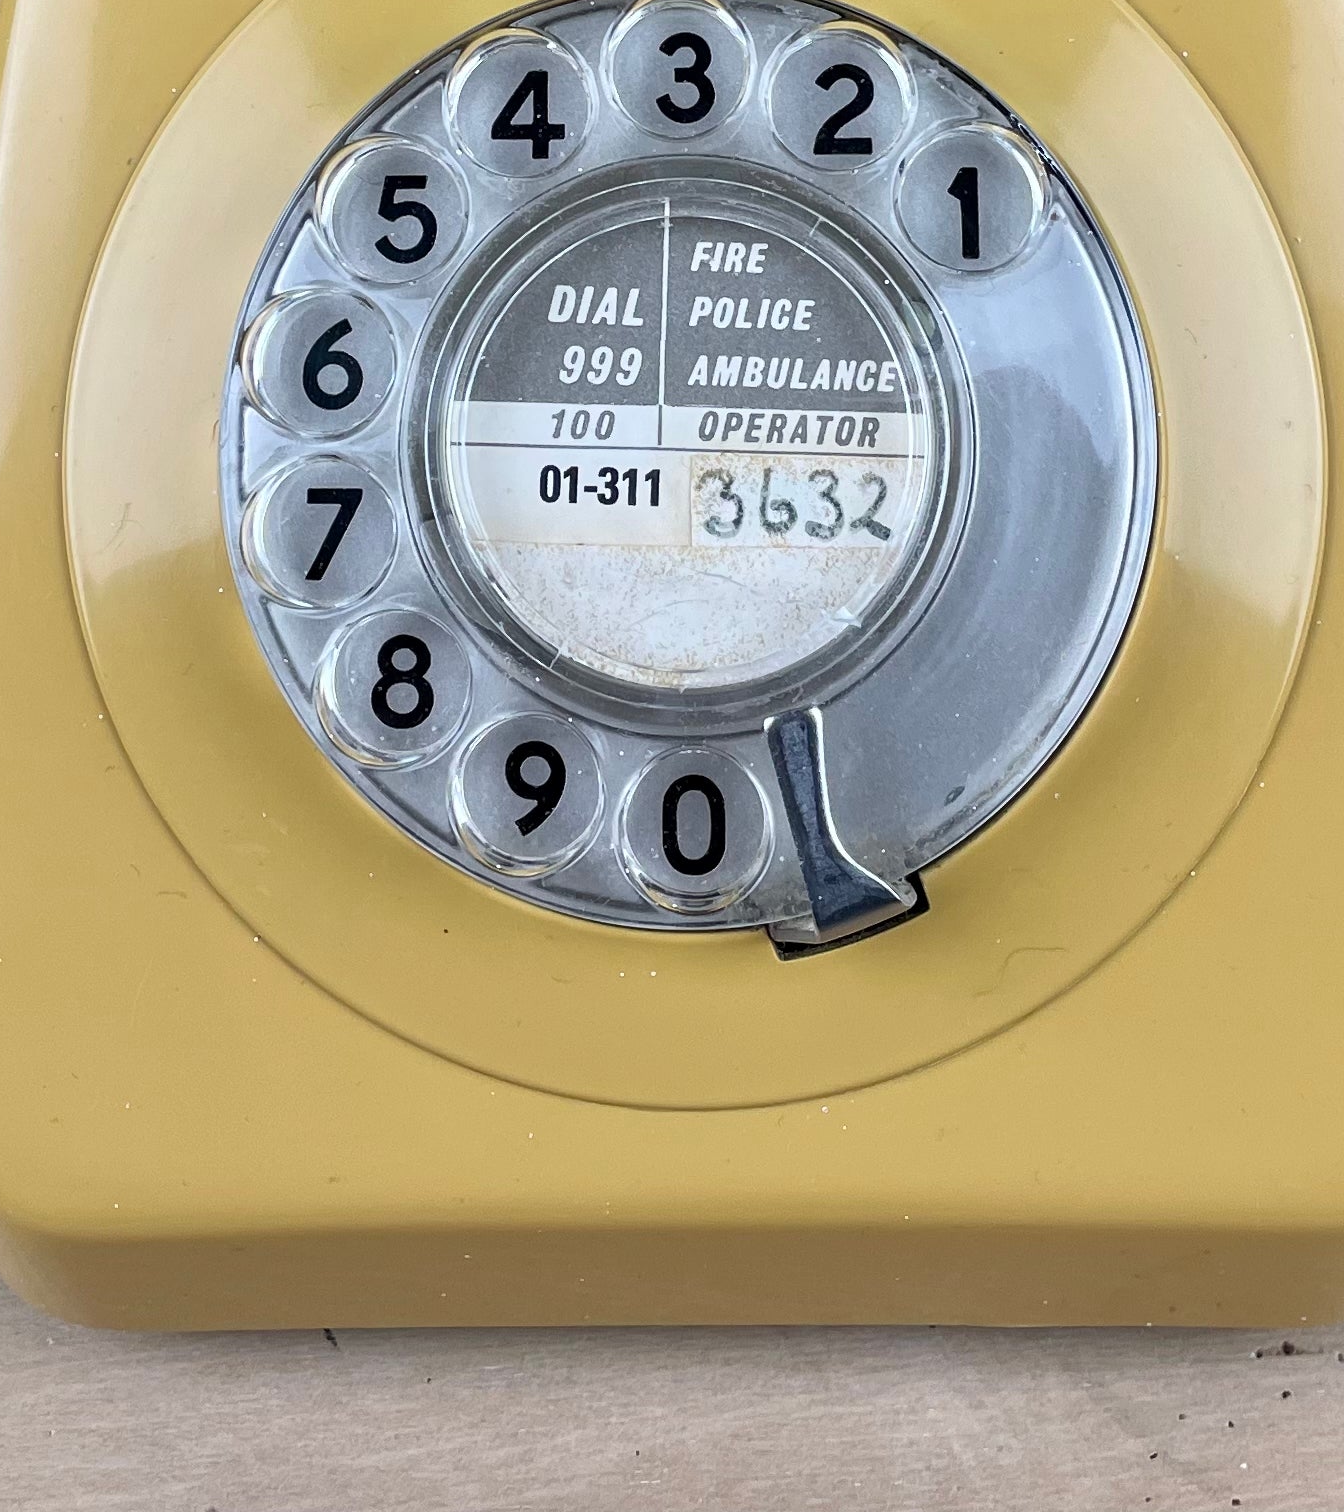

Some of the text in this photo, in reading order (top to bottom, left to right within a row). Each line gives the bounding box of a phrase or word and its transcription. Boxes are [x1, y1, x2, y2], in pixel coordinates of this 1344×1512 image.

[489, 68, 566, 161] 4
[656, 31, 718, 125] 3
[812, 62, 875, 156] 2
[374, 174, 439, 265] 5
[689, 240, 770, 275] FIRE
[946, 166, 981, 260] 1
[547, 284, 646, 328] DIAL
[687, 296, 816, 332] POLICE
[301, 317, 364, 412] 6
[557, 345, 644, 388] 999
[687, 354, 903, 393] AMBULANCE
[549, 409, 881, 450] 100 OPERATOR
[538, 463, 662, 508] 01-311
[694, 465, 894, 544] 3632
[304, 487, 364, 583] 7
[369, 633, 436, 730] 8
[503, 739, 568, 837] 9
[662, 772, 726, 877] 0
